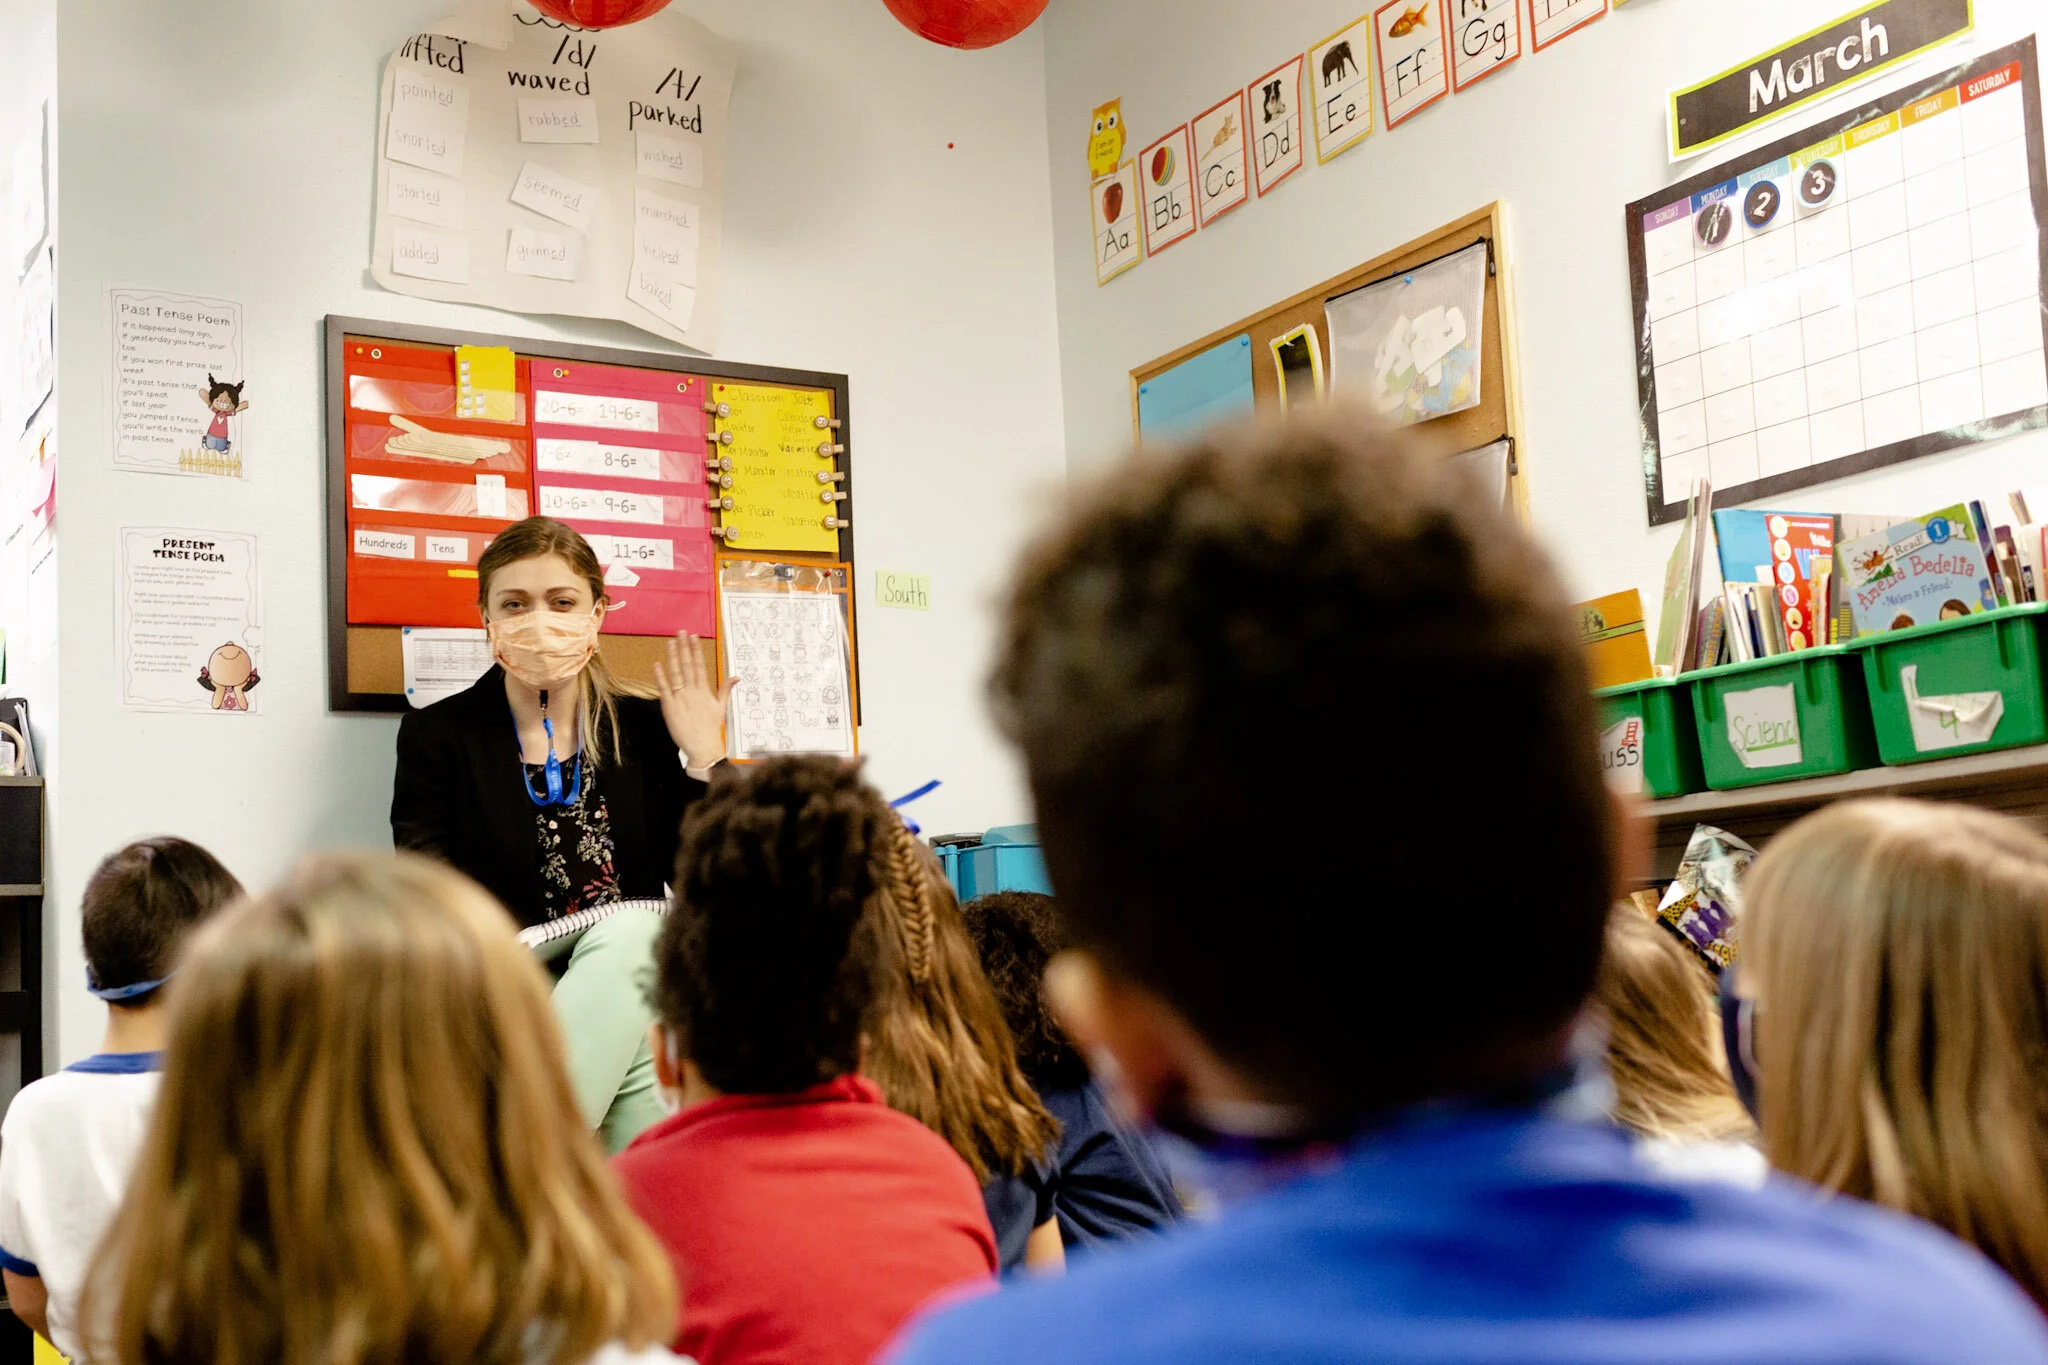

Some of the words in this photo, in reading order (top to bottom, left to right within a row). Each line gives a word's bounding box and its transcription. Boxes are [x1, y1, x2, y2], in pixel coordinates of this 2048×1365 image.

[1462, 18, 1507, 60] Gg
[1395, 48, 1426, 98] Ff
[1749, 17, 1889, 113] March
[401, 83, 453, 105] pointed
[507, 70, 591, 96] waved
[1967, 69, 2011, 97] SATURDAY
[528, 112, 580, 127] rubbed
[629, 99, 703, 134] parked
[1326, 93, 1357, 134] Ee
[1914, 98, 1943, 119] FRIDAY
[394, 129, 446, 154] snorted
[1262, 119, 1290, 168] Dd
[523, 174, 582, 208] seemed
[1204, 163, 1236, 198] Cc
[1810, 169, 1827, 196] 3
[396, 183, 440, 204] started
[1701, 184, 1728, 205] MONDAY
[1753, 191, 1772, 218] 2
[1153, 191, 1182, 231] Bb
[1655, 204, 1679, 224] SUNDAY
[400, 245, 440, 263] added
[1103, 229, 1129, 262] Aa
[121, 304, 150, 316] Past
[155, 307, 193, 321] Tense
[197, 313, 231, 326] Poem
[599, 403, 641, 421] 19-6=
[604, 452, 637, 468] 8-6=
[544, 494, 588, 510] 10-6=
[604, 497, 637, 513] 9-6=
[153, 550, 190, 560] TENSE
[193, 552, 225, 562] POEM
[162, 538, 215, 551] PRESENT
[359, 537, 408, 550] Hundreds
[432, 543, 455, 553] Tens
[614, 544, 655, 560] 11-6=
[1909, 553, 1975, 577] Bedelia
[885, 575, 928, 606] South
